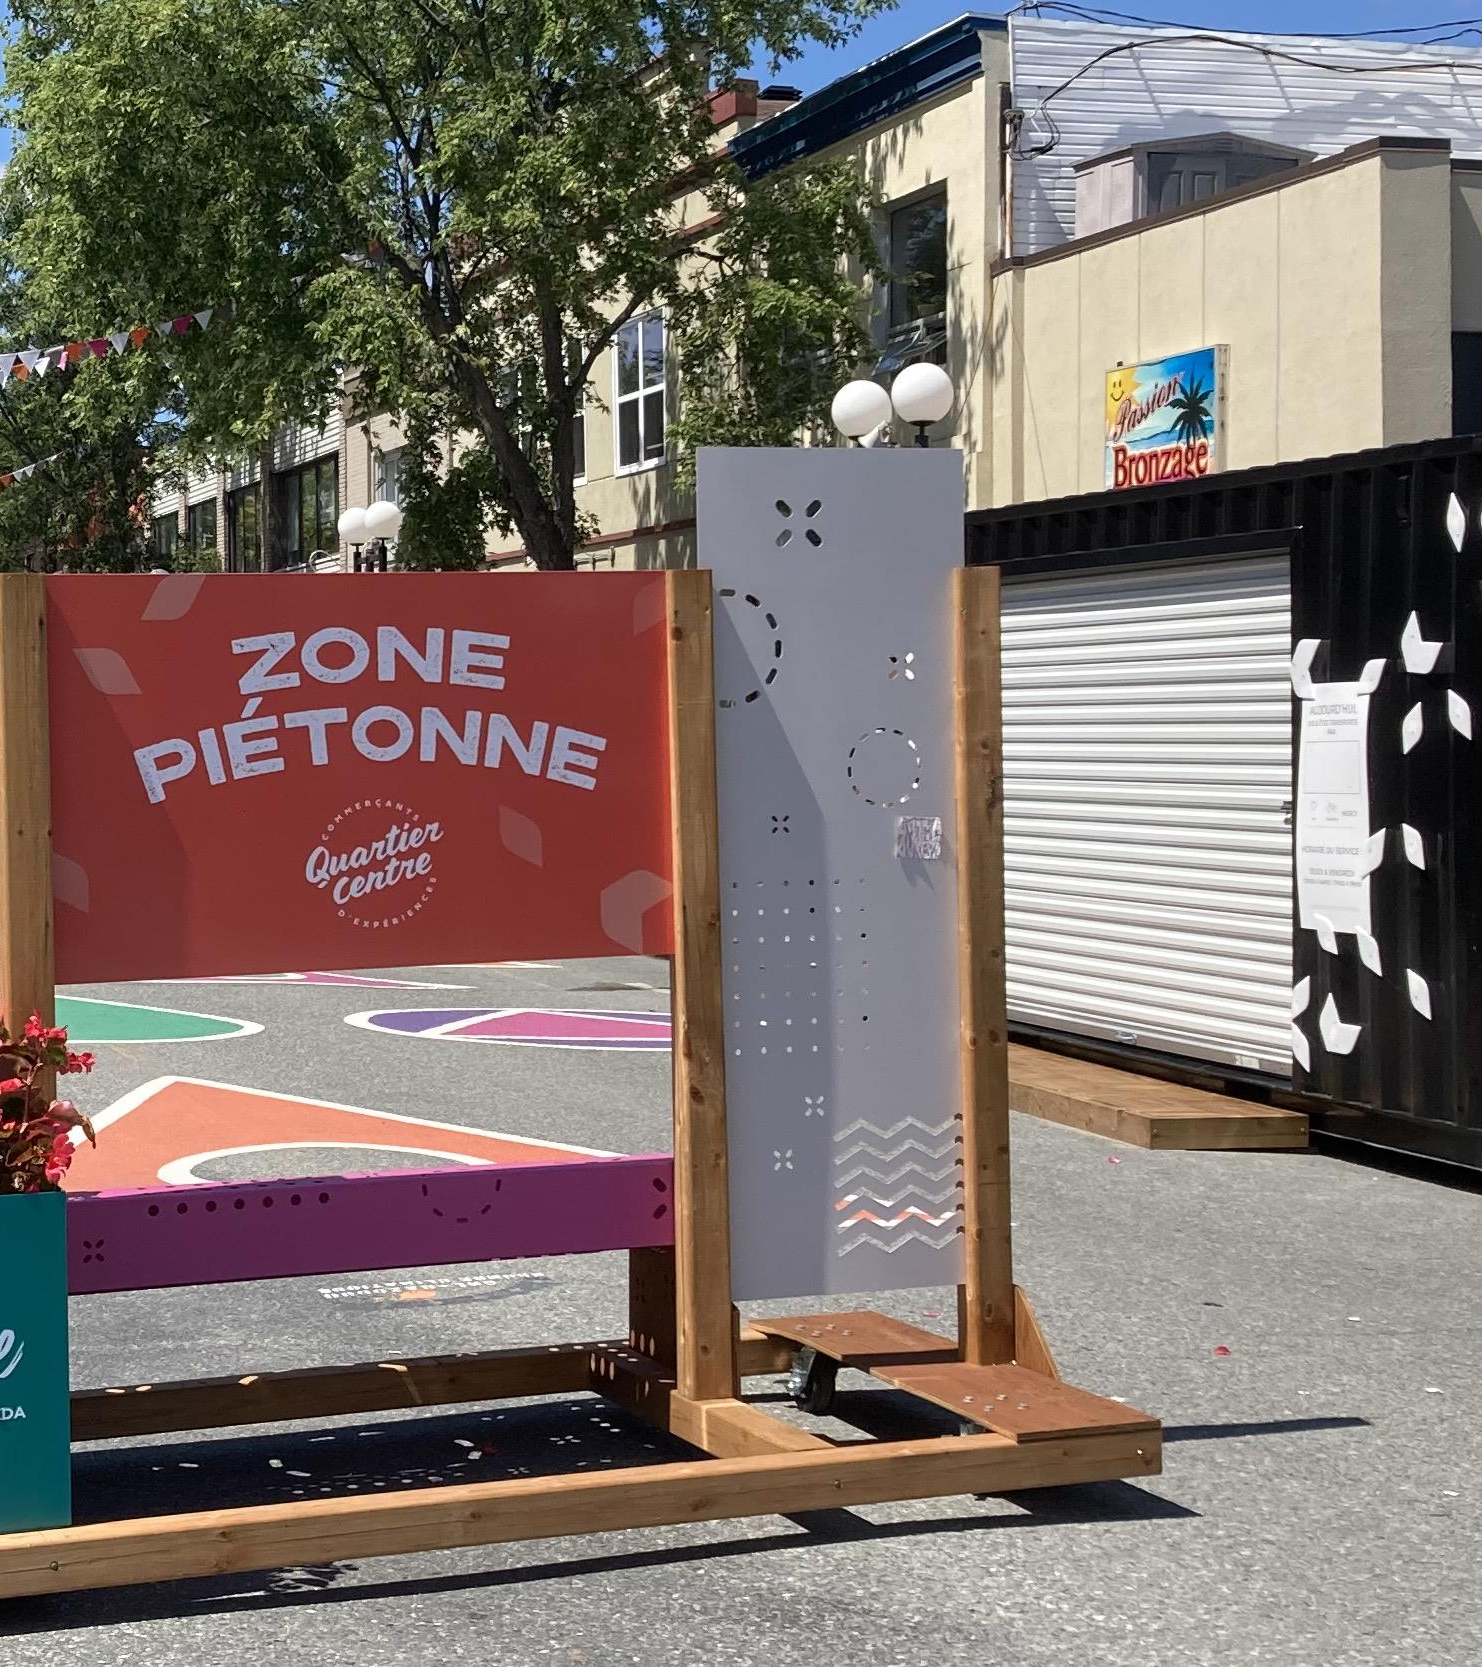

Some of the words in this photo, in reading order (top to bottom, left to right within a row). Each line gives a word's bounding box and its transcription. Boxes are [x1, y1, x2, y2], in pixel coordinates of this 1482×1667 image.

[1113, 370, 1186, 441] Passion
[1112, 441, 1209, 488] Bronzage
[231, 626, 510, 694] ZONE
[133, 696, 607, 804] PIÉTONNE
[321, 798, 421, 841] COMMERÇANTS
[305, 821, 444, 889] Quartier
